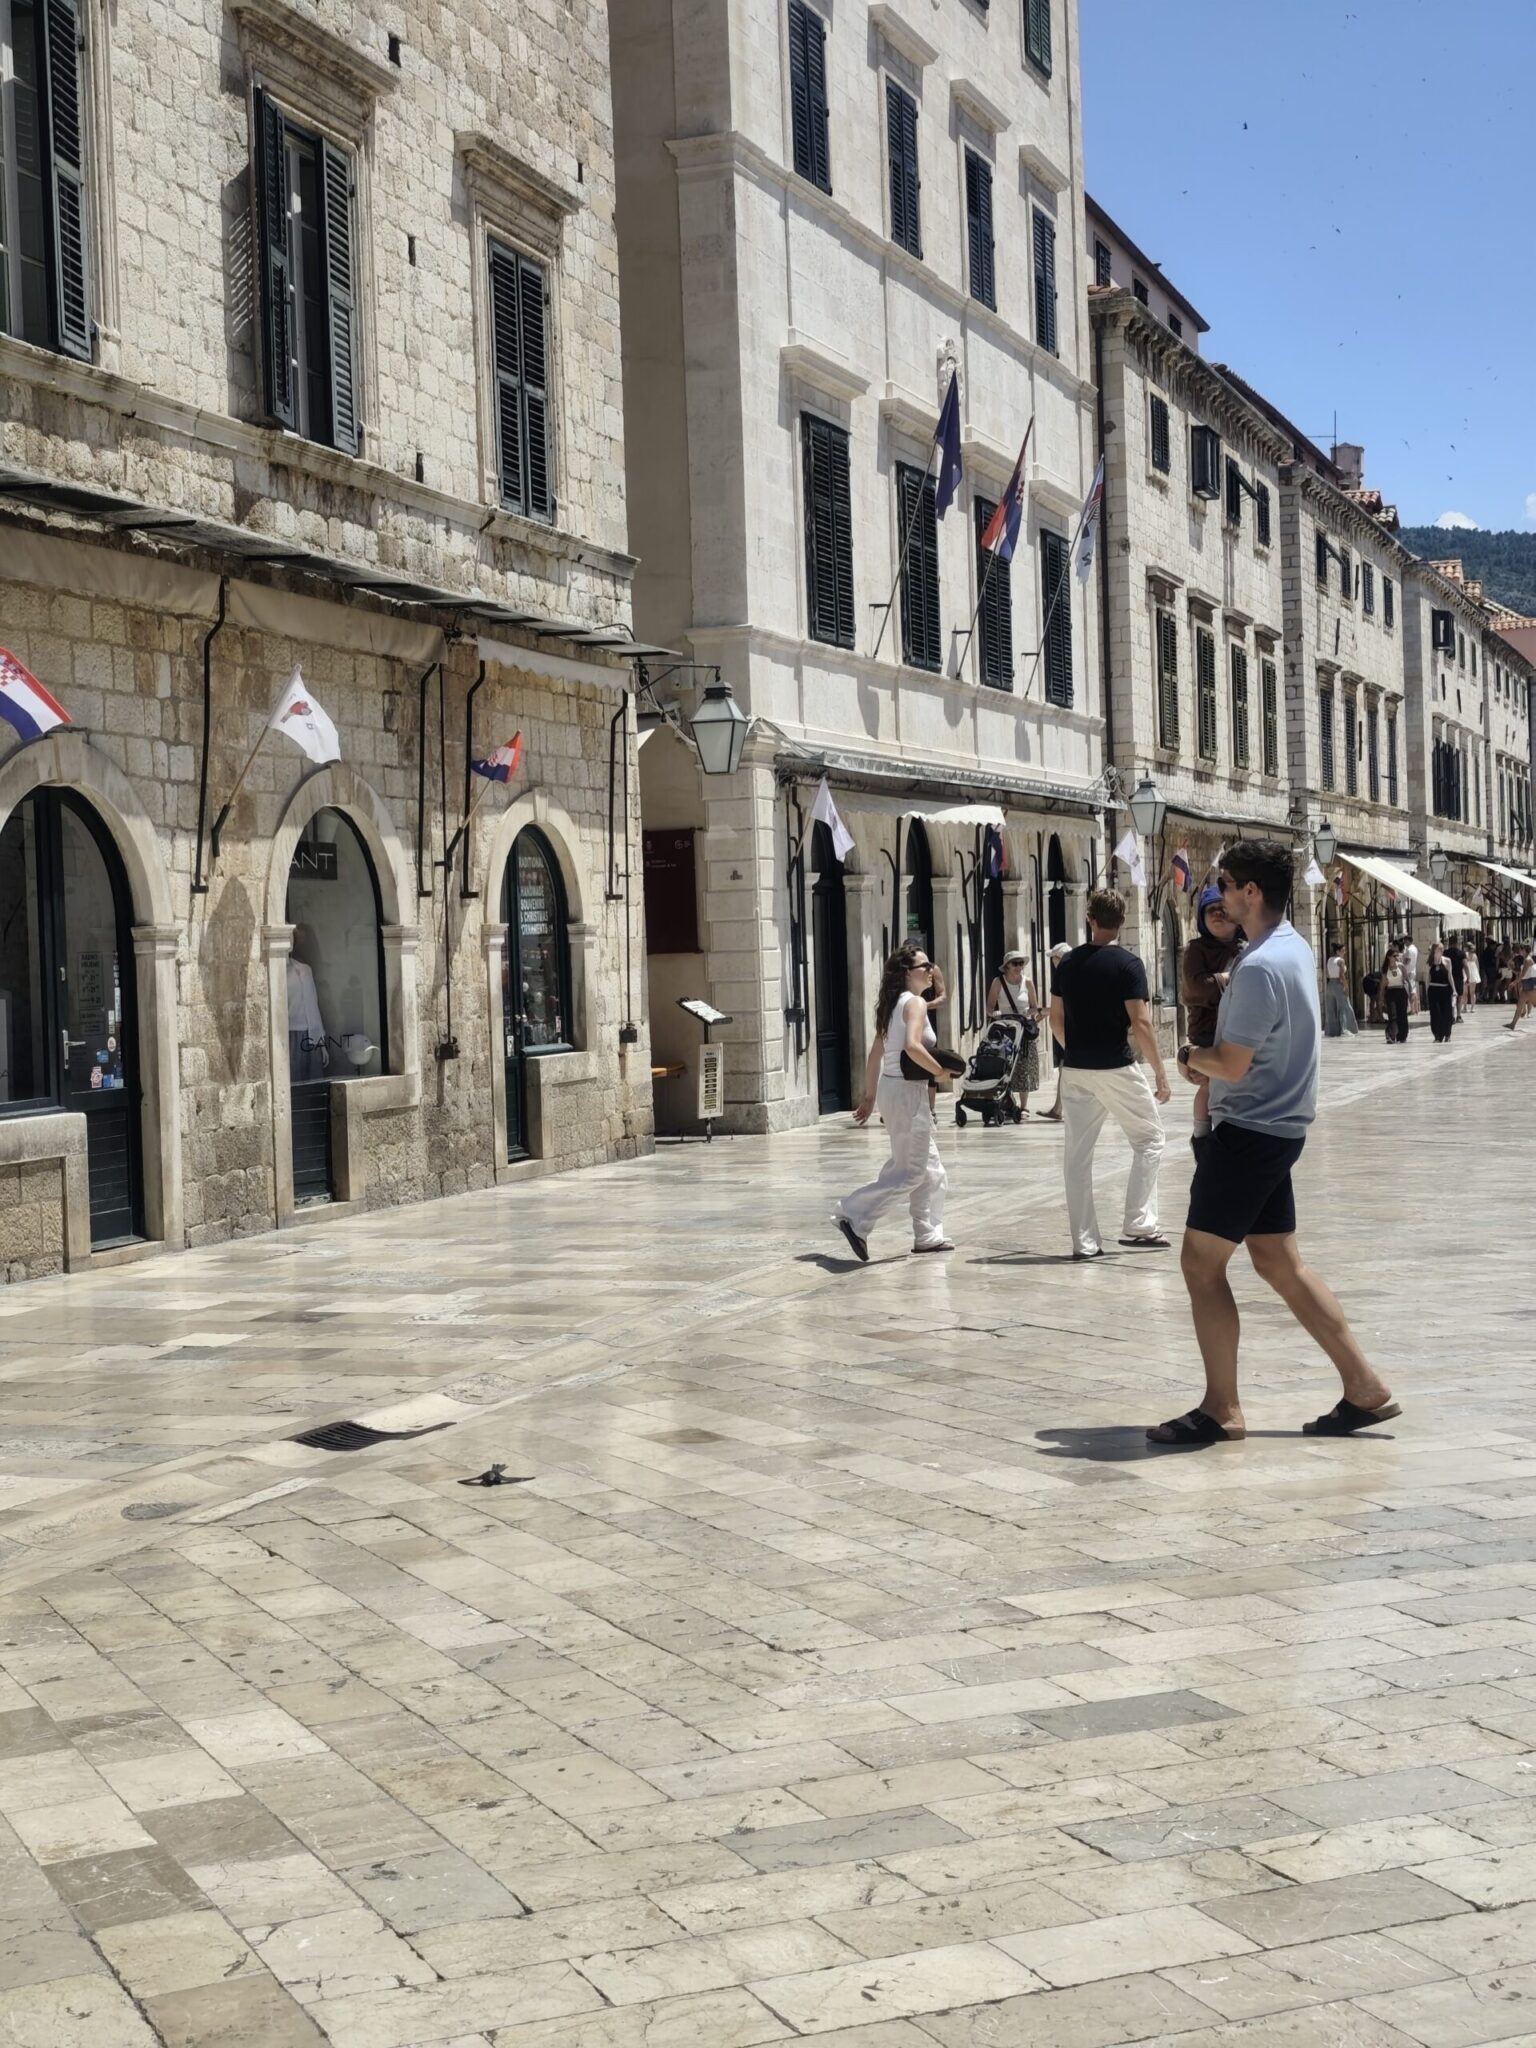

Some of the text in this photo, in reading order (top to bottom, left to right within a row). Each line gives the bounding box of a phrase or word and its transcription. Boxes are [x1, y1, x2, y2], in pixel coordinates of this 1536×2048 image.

[291, 852, 334, 870] ANT
[520, 898, 545, 910] SOUVENIRS
[524, 910, 549, 923] CHRISTMAS
[301, 1034, 354, 1052] GANT
